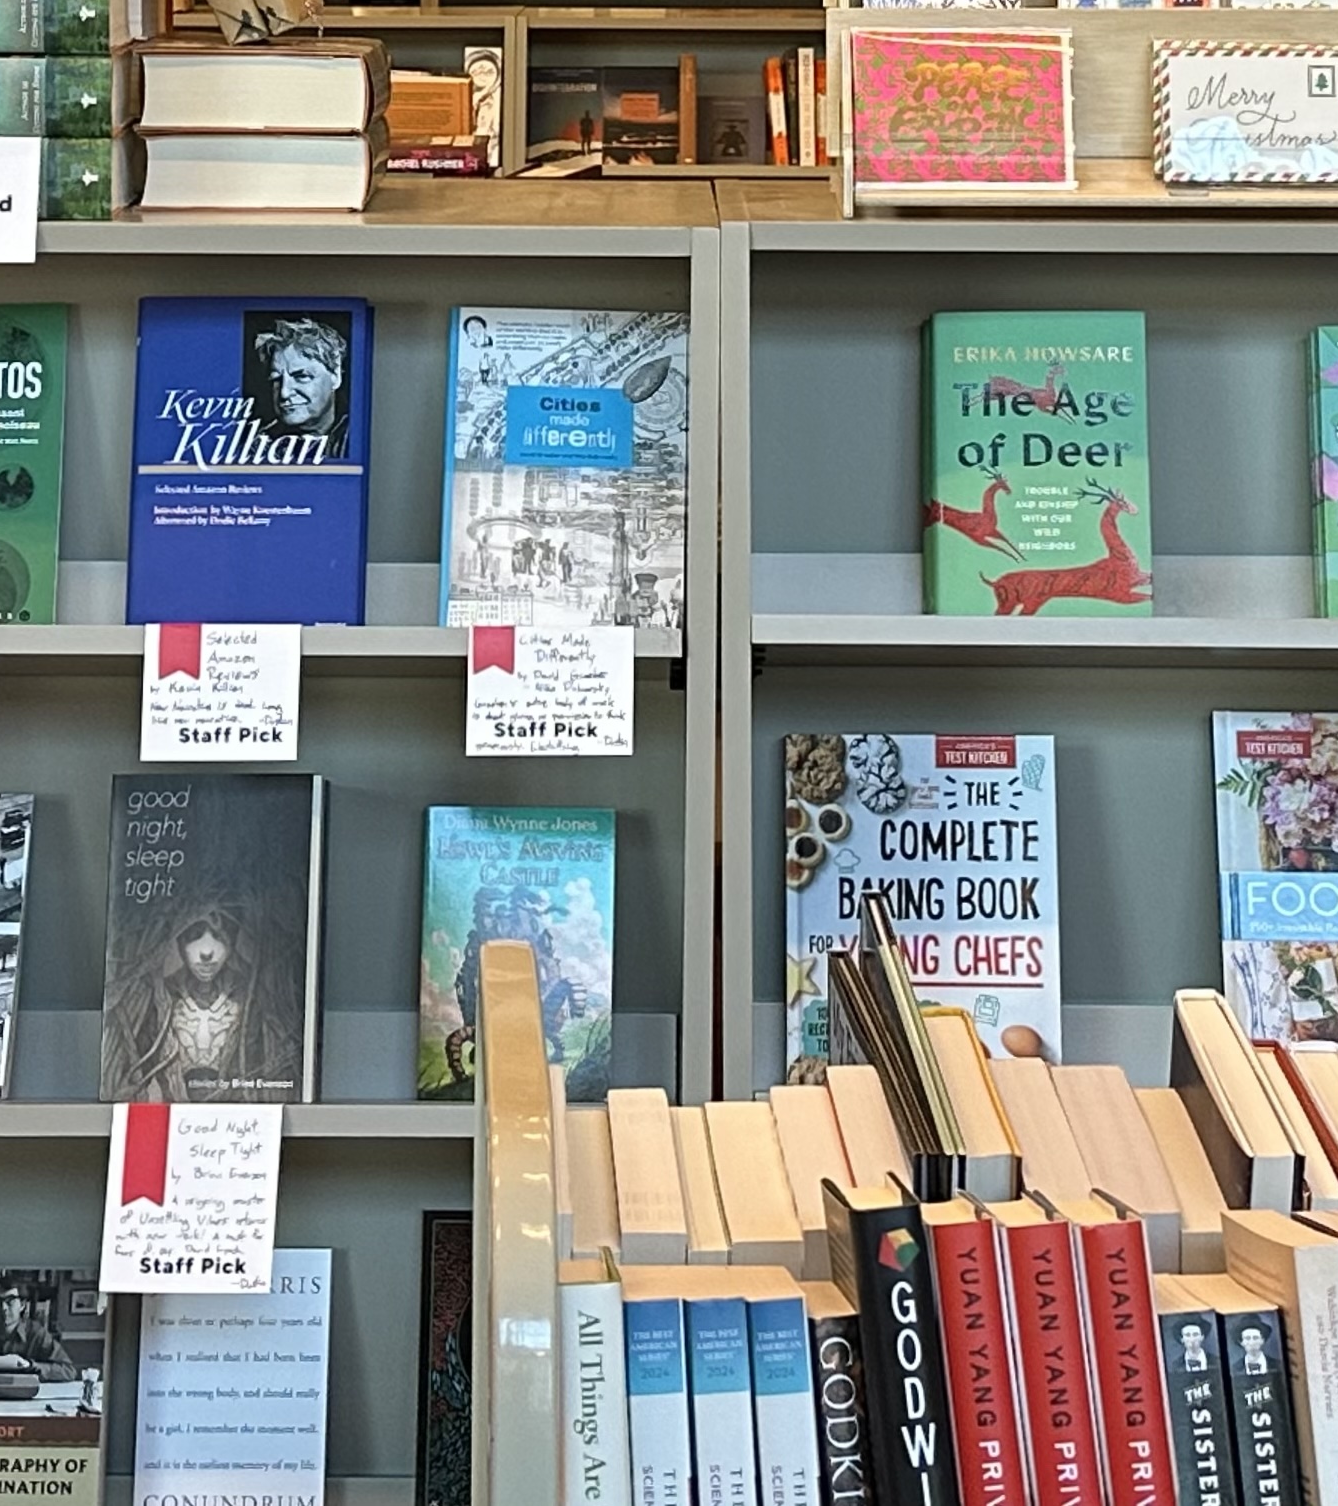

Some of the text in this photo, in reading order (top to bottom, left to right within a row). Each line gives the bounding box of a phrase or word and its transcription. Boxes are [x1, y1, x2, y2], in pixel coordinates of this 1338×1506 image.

[1187, 73, 1276, 115] Merry
[954, 347, 1017, 362] ERIKA
[158, 389, 255, 422] Kevin
[540, 397, 601, 412] Cities
[954, 382, 1134, 426] The Age
[550, 414, 590, 425] made
[173, 422, 329, 469] Killian
[958, 431, 1130, 468] of Deer
[178, 727, 283, 744] Staff Pick
[128, 785, 191, 812] good
[965, 782, 1001, 805] THE
[127, 814, 188, 842] night,
[880, 819, 1038, 861] COMPLETE
[125, 845, 184, 871] sleep
[125, 875, 175, 903] tight
[957, 876, 1040, 920] BOOK
[809, 936, 834, 952] FOR
[955, 934, 1042, 977] CHEFS
[958, 1247, 997, 1427] YUAN YANG
[573, 1310, 606, 1500] All Things Are
[66, 1457, 88, 1473] OF
